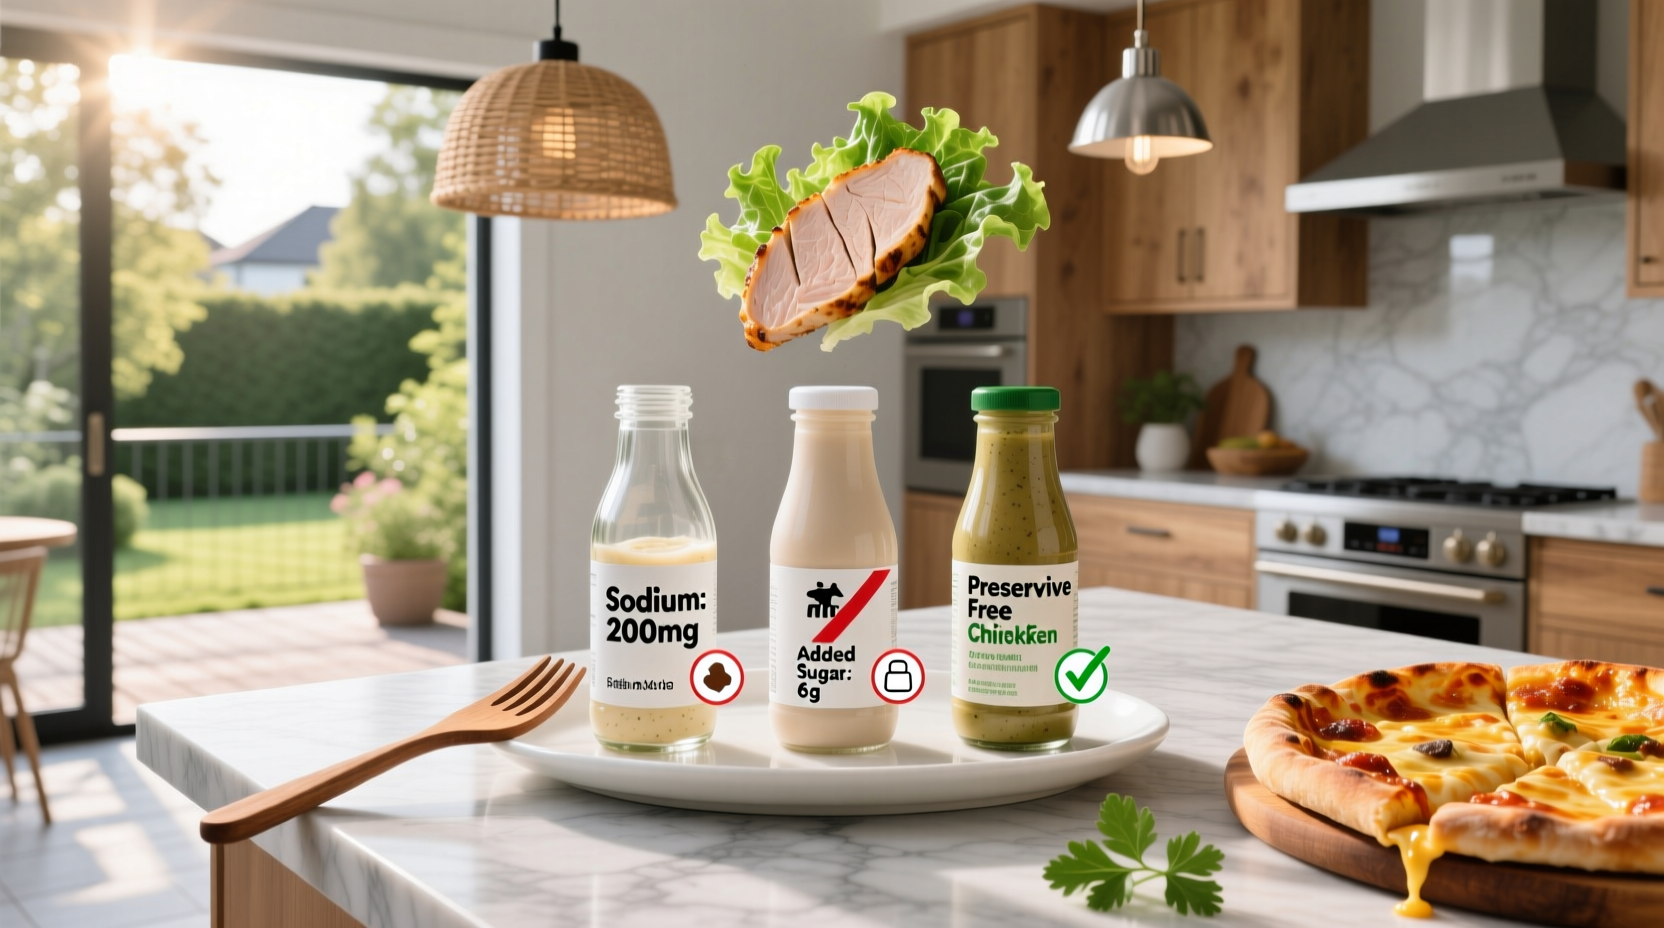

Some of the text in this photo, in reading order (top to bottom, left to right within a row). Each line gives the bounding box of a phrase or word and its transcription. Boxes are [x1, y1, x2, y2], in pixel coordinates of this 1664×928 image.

[968, 574, 1071, 598] Preservive
[606, 586, 706, 613] Sodium:
[968, 598, 1012, 620] Free
[606, 617, 699, 649] 200mg
[797, 645, 856, 662] Added
[797, 663, 851, 684] Sugar:
[797, 682, 821, 703] 6g
